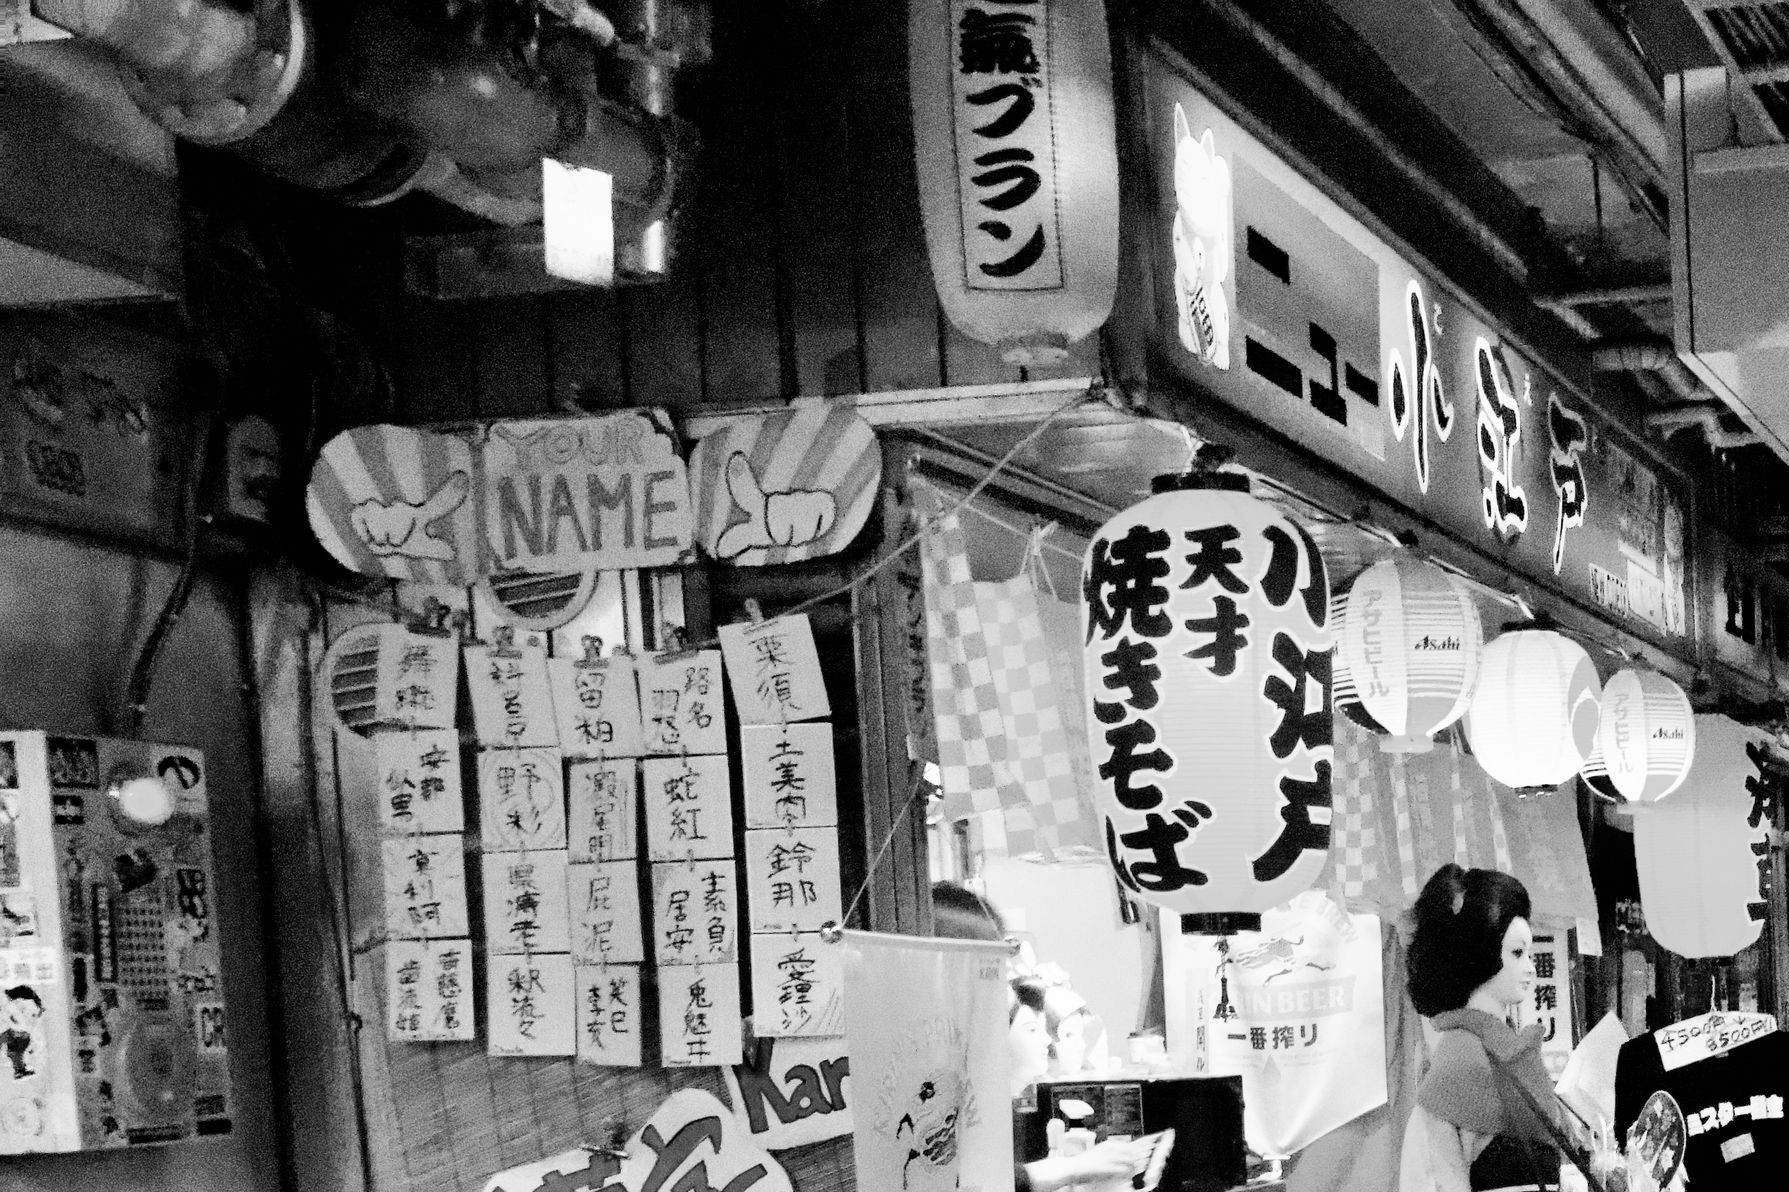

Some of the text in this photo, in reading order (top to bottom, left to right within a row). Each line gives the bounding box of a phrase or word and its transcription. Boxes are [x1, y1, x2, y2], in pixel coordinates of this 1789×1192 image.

[492, 418, 646, 468] YOUR
[501, 469, 679, 561] NAME
[1179, 524, 1250, 677] 天才
[1414, 634, 1461, 652] Asahi
[1652, 726, 1685, 740] Asahi
[1279, 985, 1346, 1015] BEER
[1227, 1023, 1318, 1050] 一番搾り
